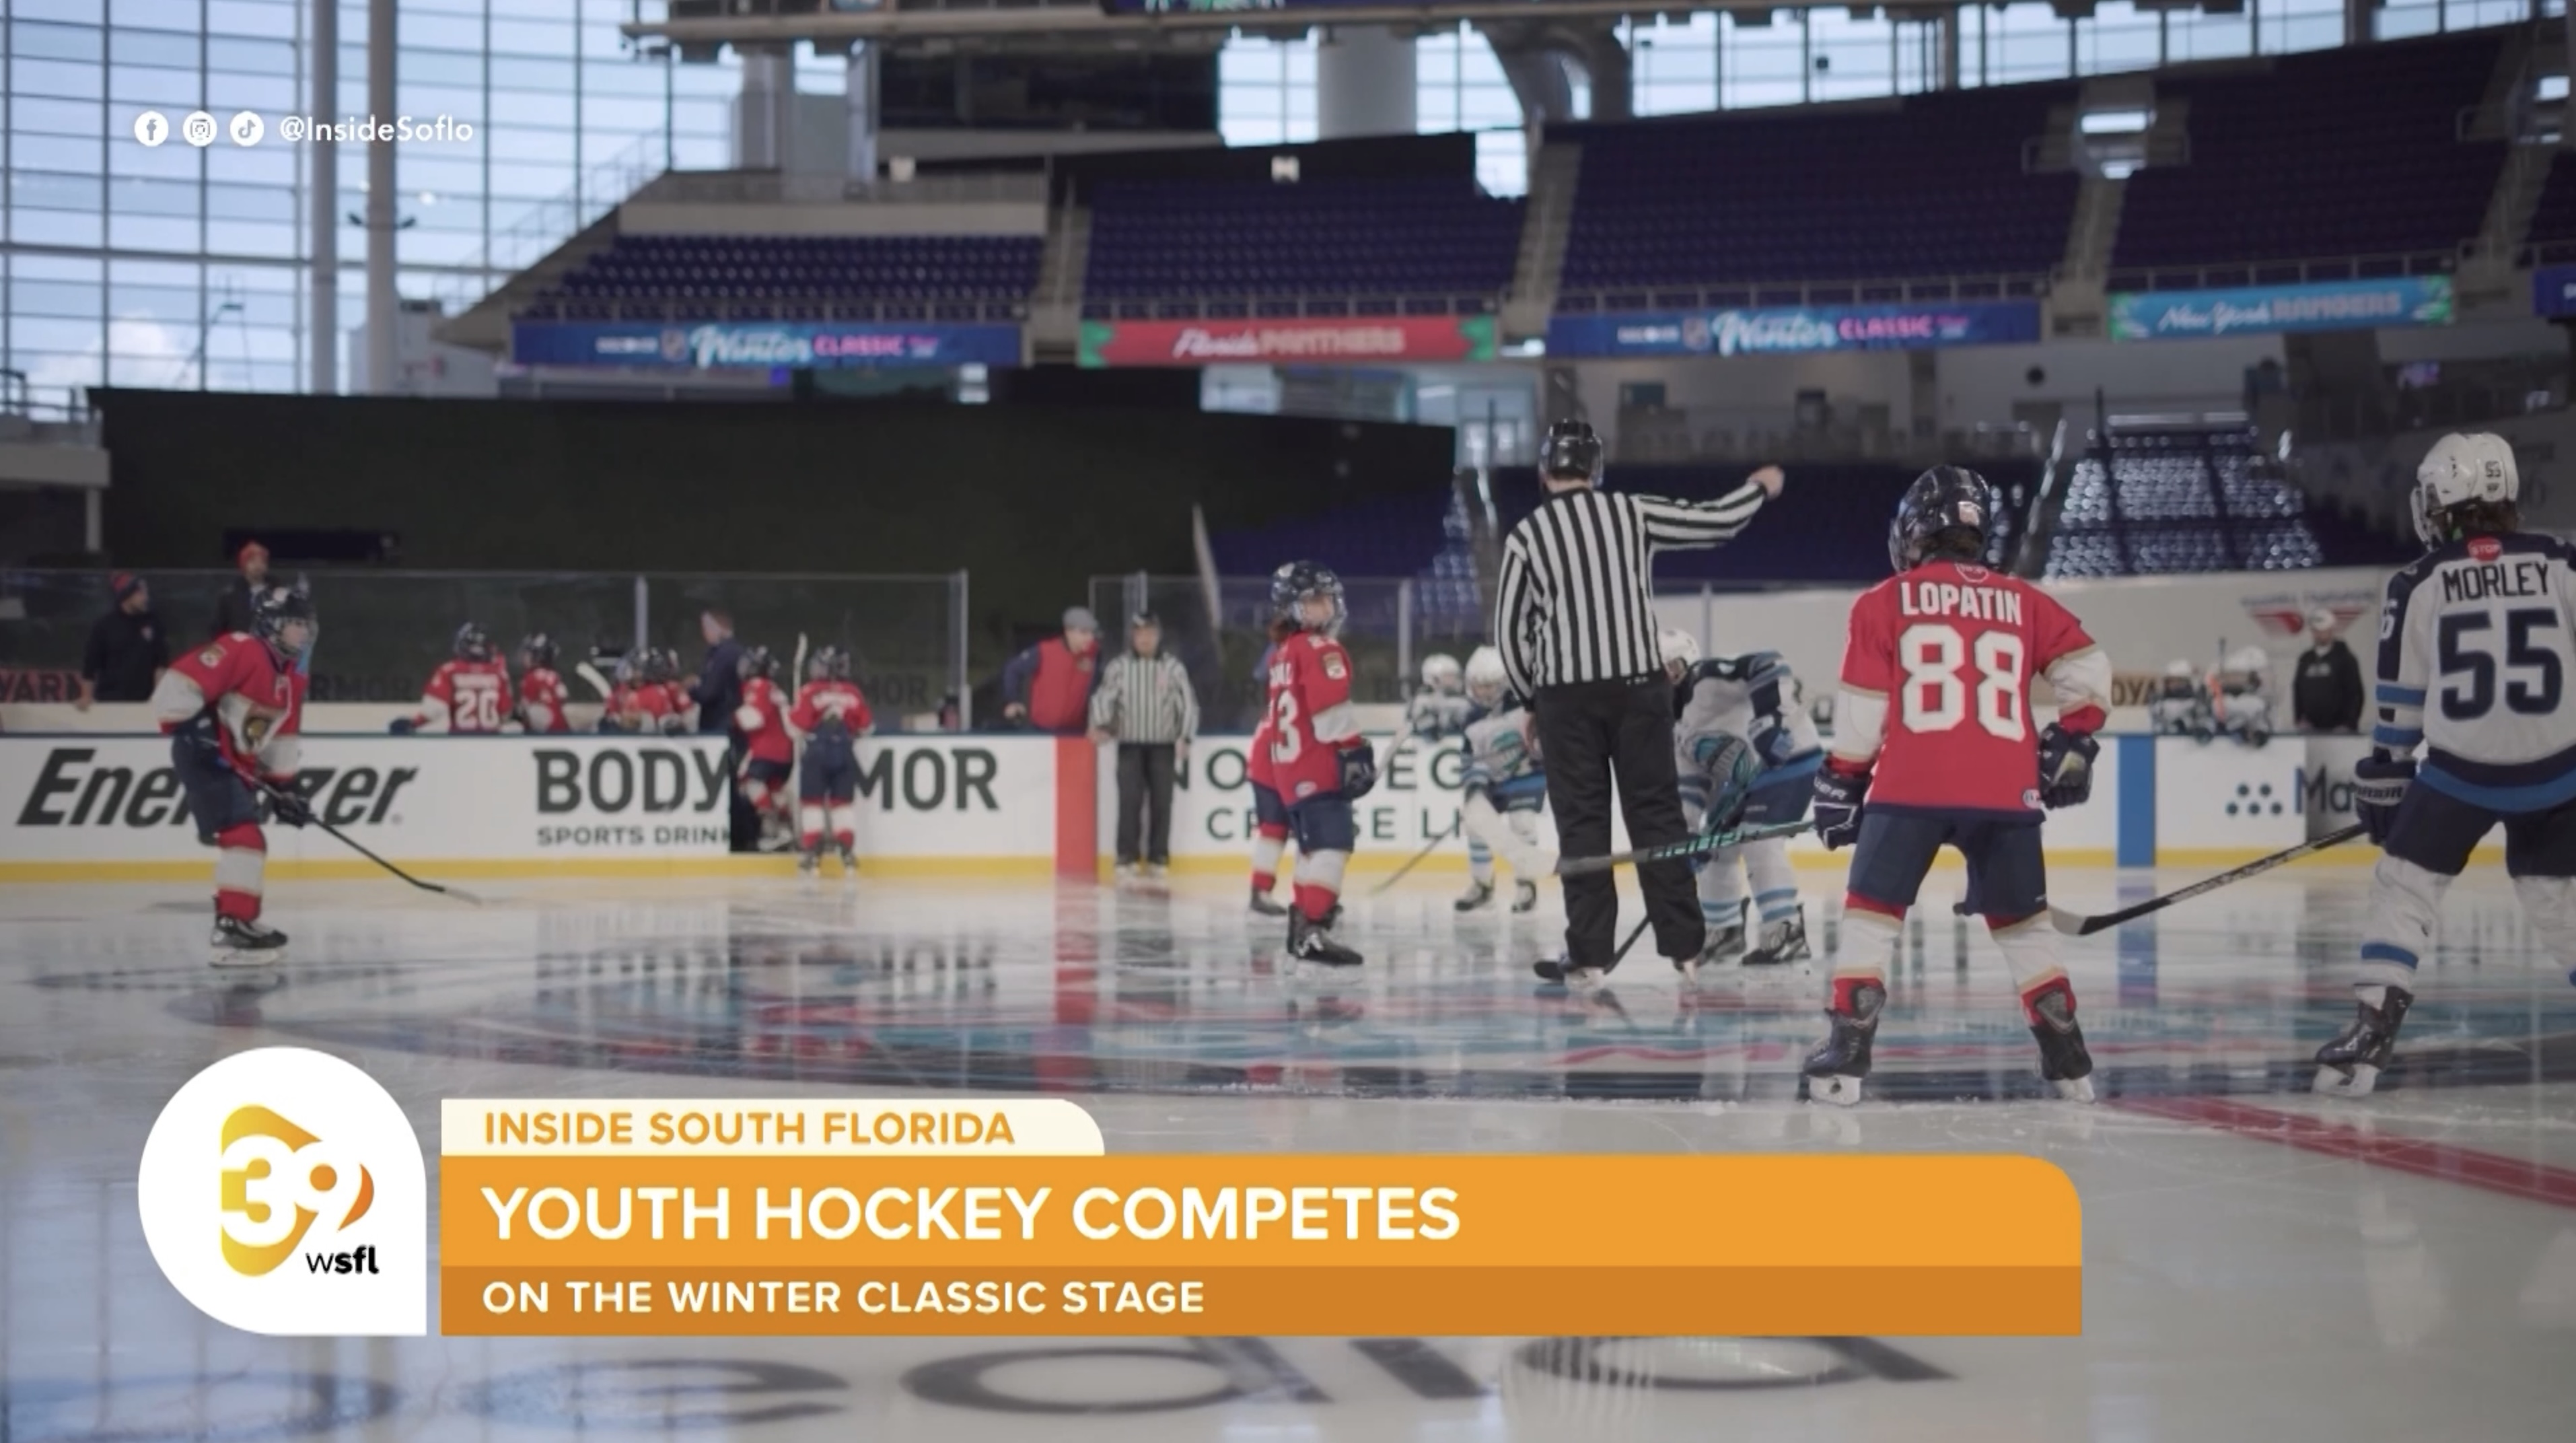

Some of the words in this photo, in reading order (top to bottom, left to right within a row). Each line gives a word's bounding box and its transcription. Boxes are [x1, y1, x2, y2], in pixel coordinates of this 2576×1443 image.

[1900, 581, 2022, 627] LOPATIN
[2441, 560, 2549, 604] MORLEY
[1899, 622, 2026, 742] 88
[2437, 607, 2563, 723] 55
[454, 691, 501, 729] 20
[537, 826, 644, 845] SPORTS
